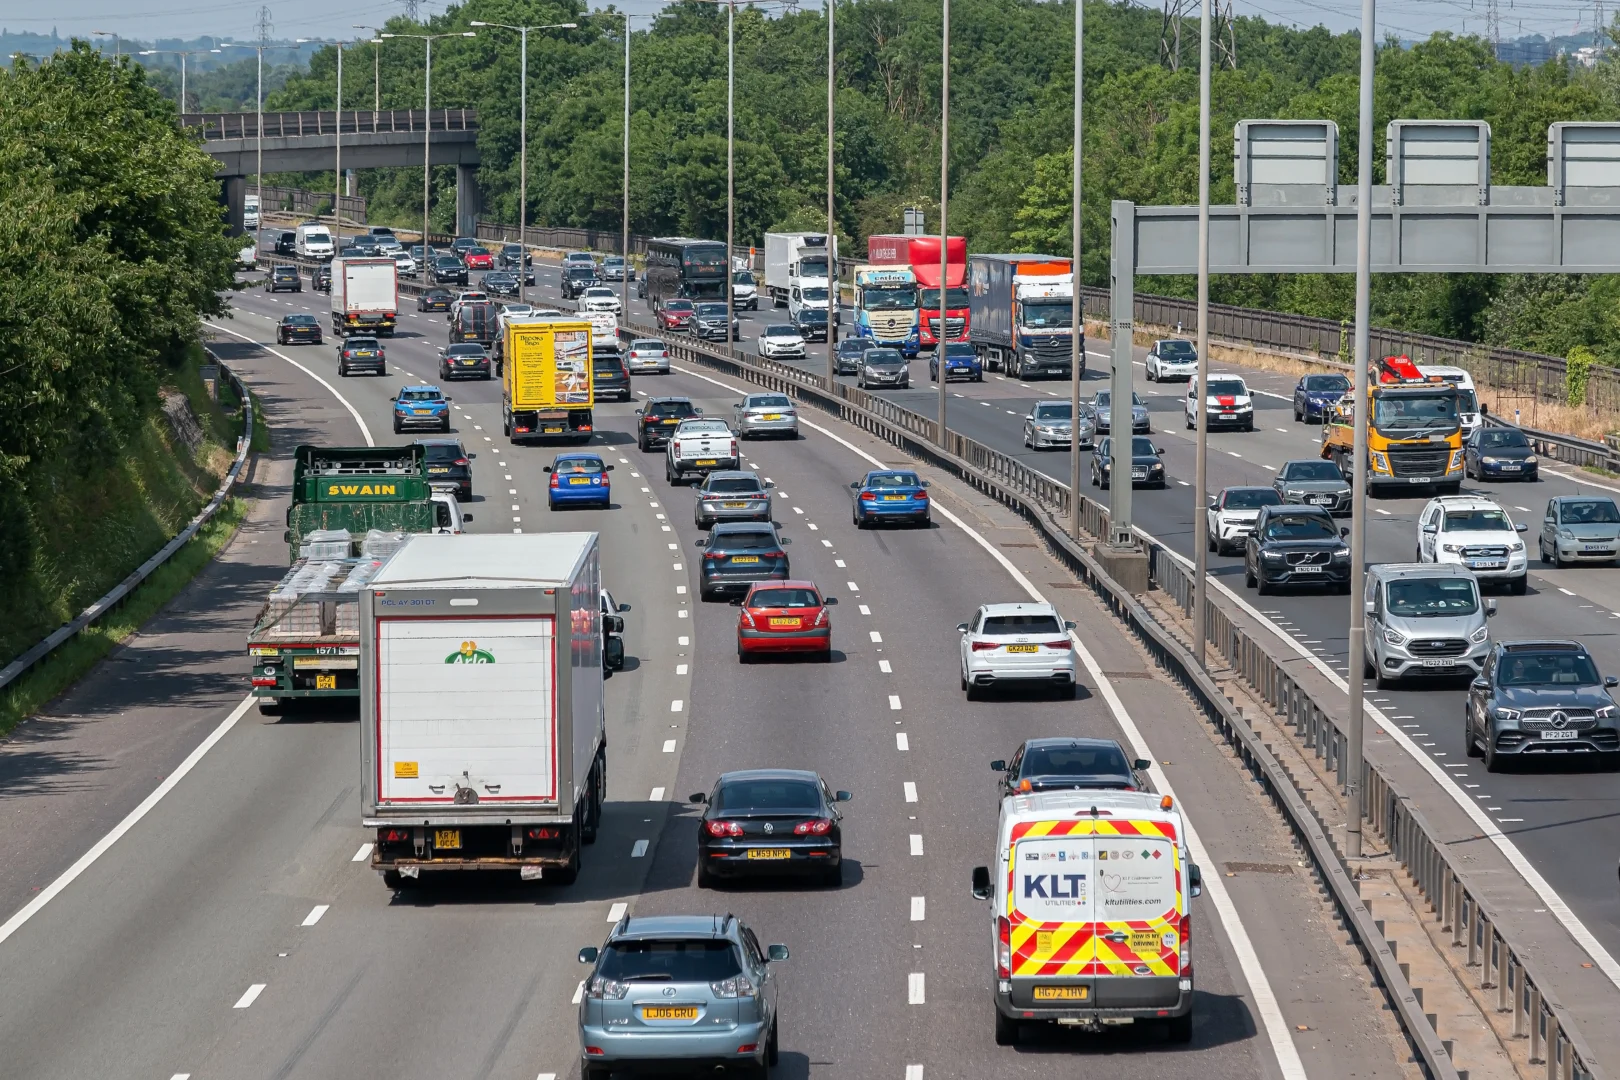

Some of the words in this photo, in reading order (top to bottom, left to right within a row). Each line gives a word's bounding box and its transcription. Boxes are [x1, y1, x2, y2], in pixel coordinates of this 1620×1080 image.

[328, 484, 396, 496] SWAIN
[315, 646, 337, 654] 1571
[438, 831, 457, 840] KR71
[439, 839, 455, 847] OCC
[772, 849, 788, 858] NPK
[1024, 874, 1087, 899] KLT
[1104, 898, 1162, 906] kltutilities.com
[1038, 987, 1063, 997] HG72
[1066, 987, 1083, 997] THV
[646, 1008, 672, 1018] LJ06
[674, 1008, 694, 1018] GRU
